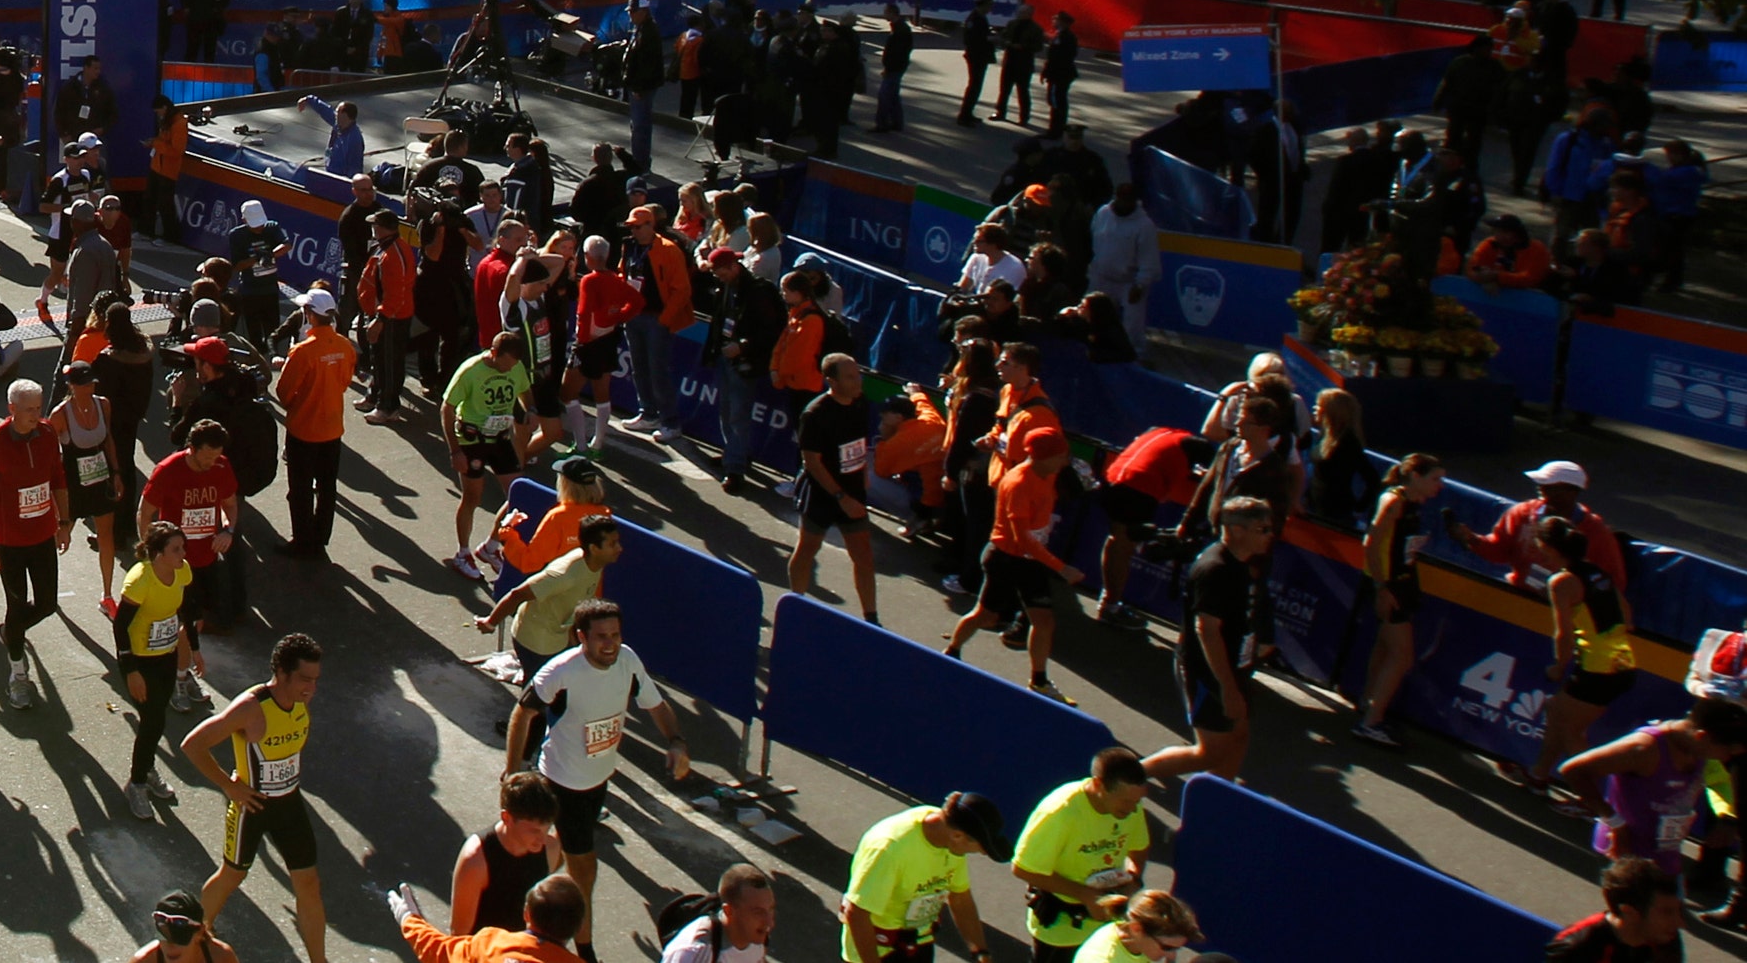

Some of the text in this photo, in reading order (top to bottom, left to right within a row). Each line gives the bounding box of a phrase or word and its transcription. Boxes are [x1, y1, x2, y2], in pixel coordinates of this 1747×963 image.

[1132, 50, 1200, 62] Mixed Zone
[850, 217, 901, 249] ING
[484, 385, 514, 405] 343
[680, 377, 788, 430] UNED
[184, 486, 218, 506] BRAD
[185, 515, 212, 527] 15-354
[1459, 651, 1516, 710] 4
[1452, 696, 1501, 724] NEW
[269, 761, 288, 770] ING
[270, 765, 296, 782] 1-660
[1077, 839, 1117, 854] Achilles
[915, 877, 949, 894] Achilles
